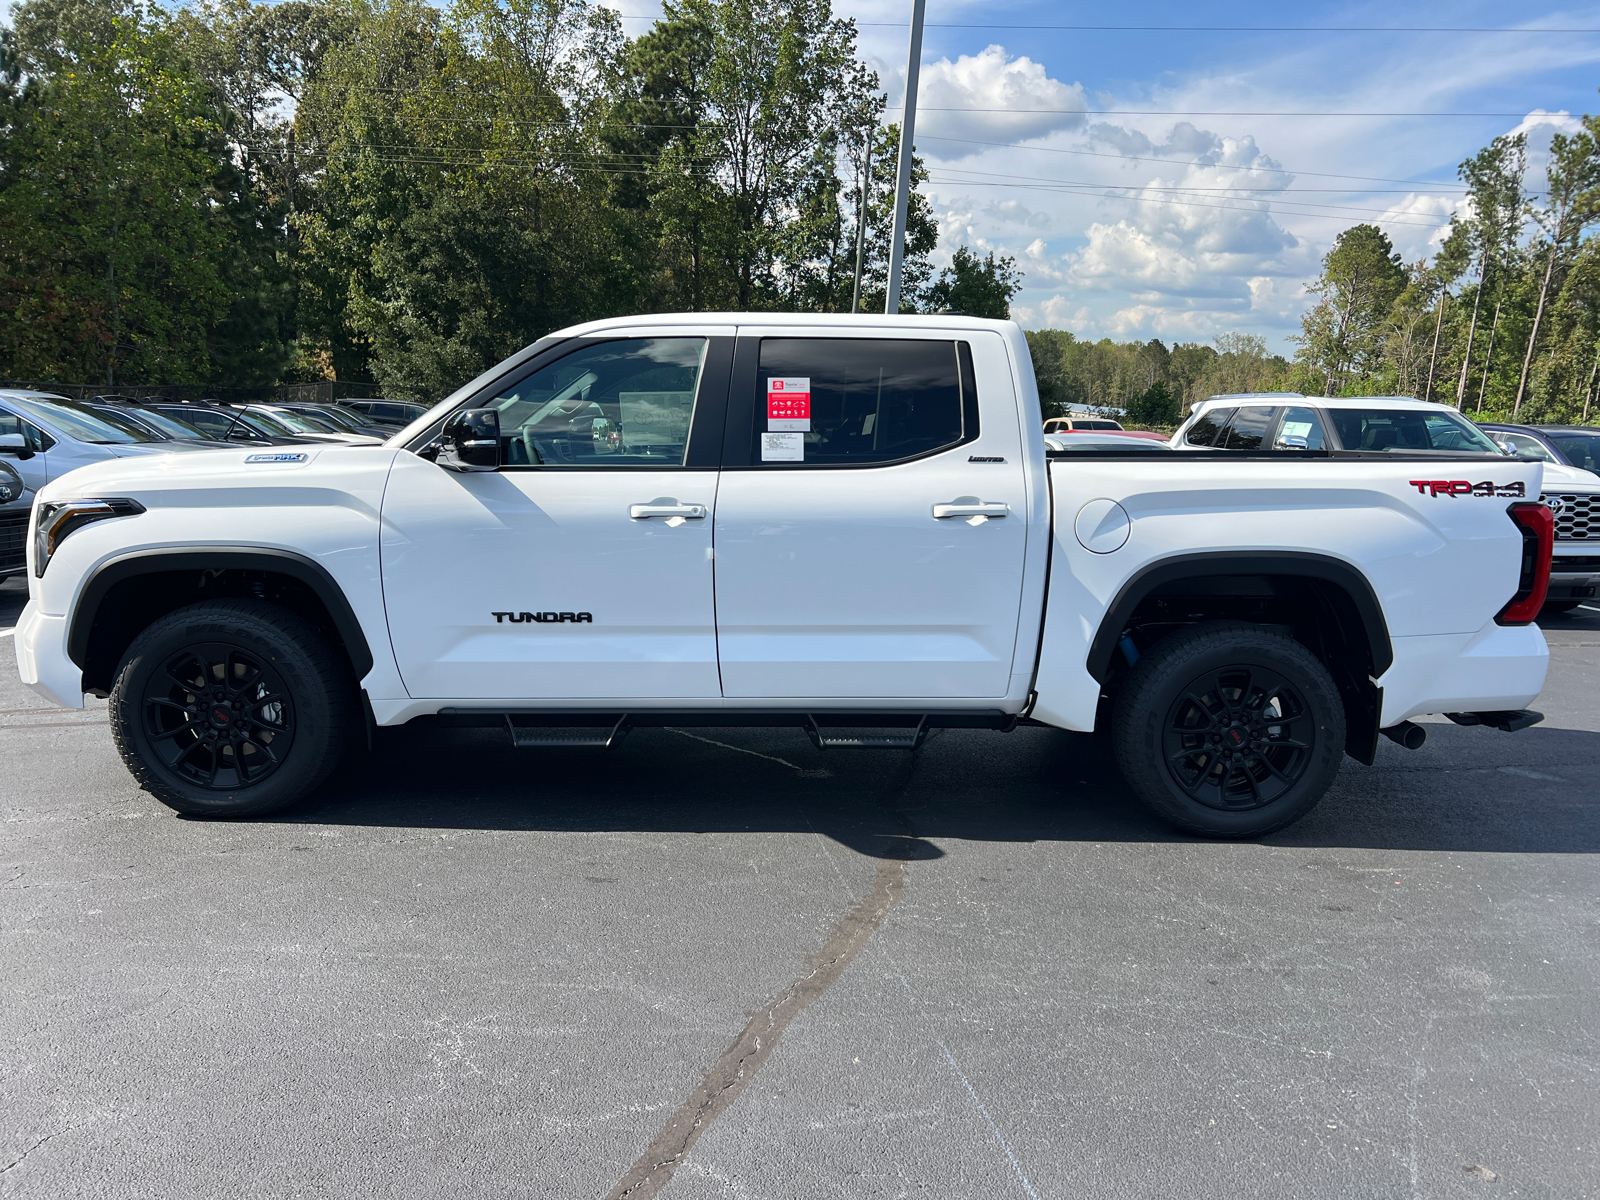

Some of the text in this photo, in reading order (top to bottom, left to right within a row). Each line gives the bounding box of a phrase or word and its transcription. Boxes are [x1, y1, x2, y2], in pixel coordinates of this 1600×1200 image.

[1409, 480, 1473, 498] TRD
[491, 612, 593, 623] TUNDRA
[185, 624, 308, 690] WILDPEAK
